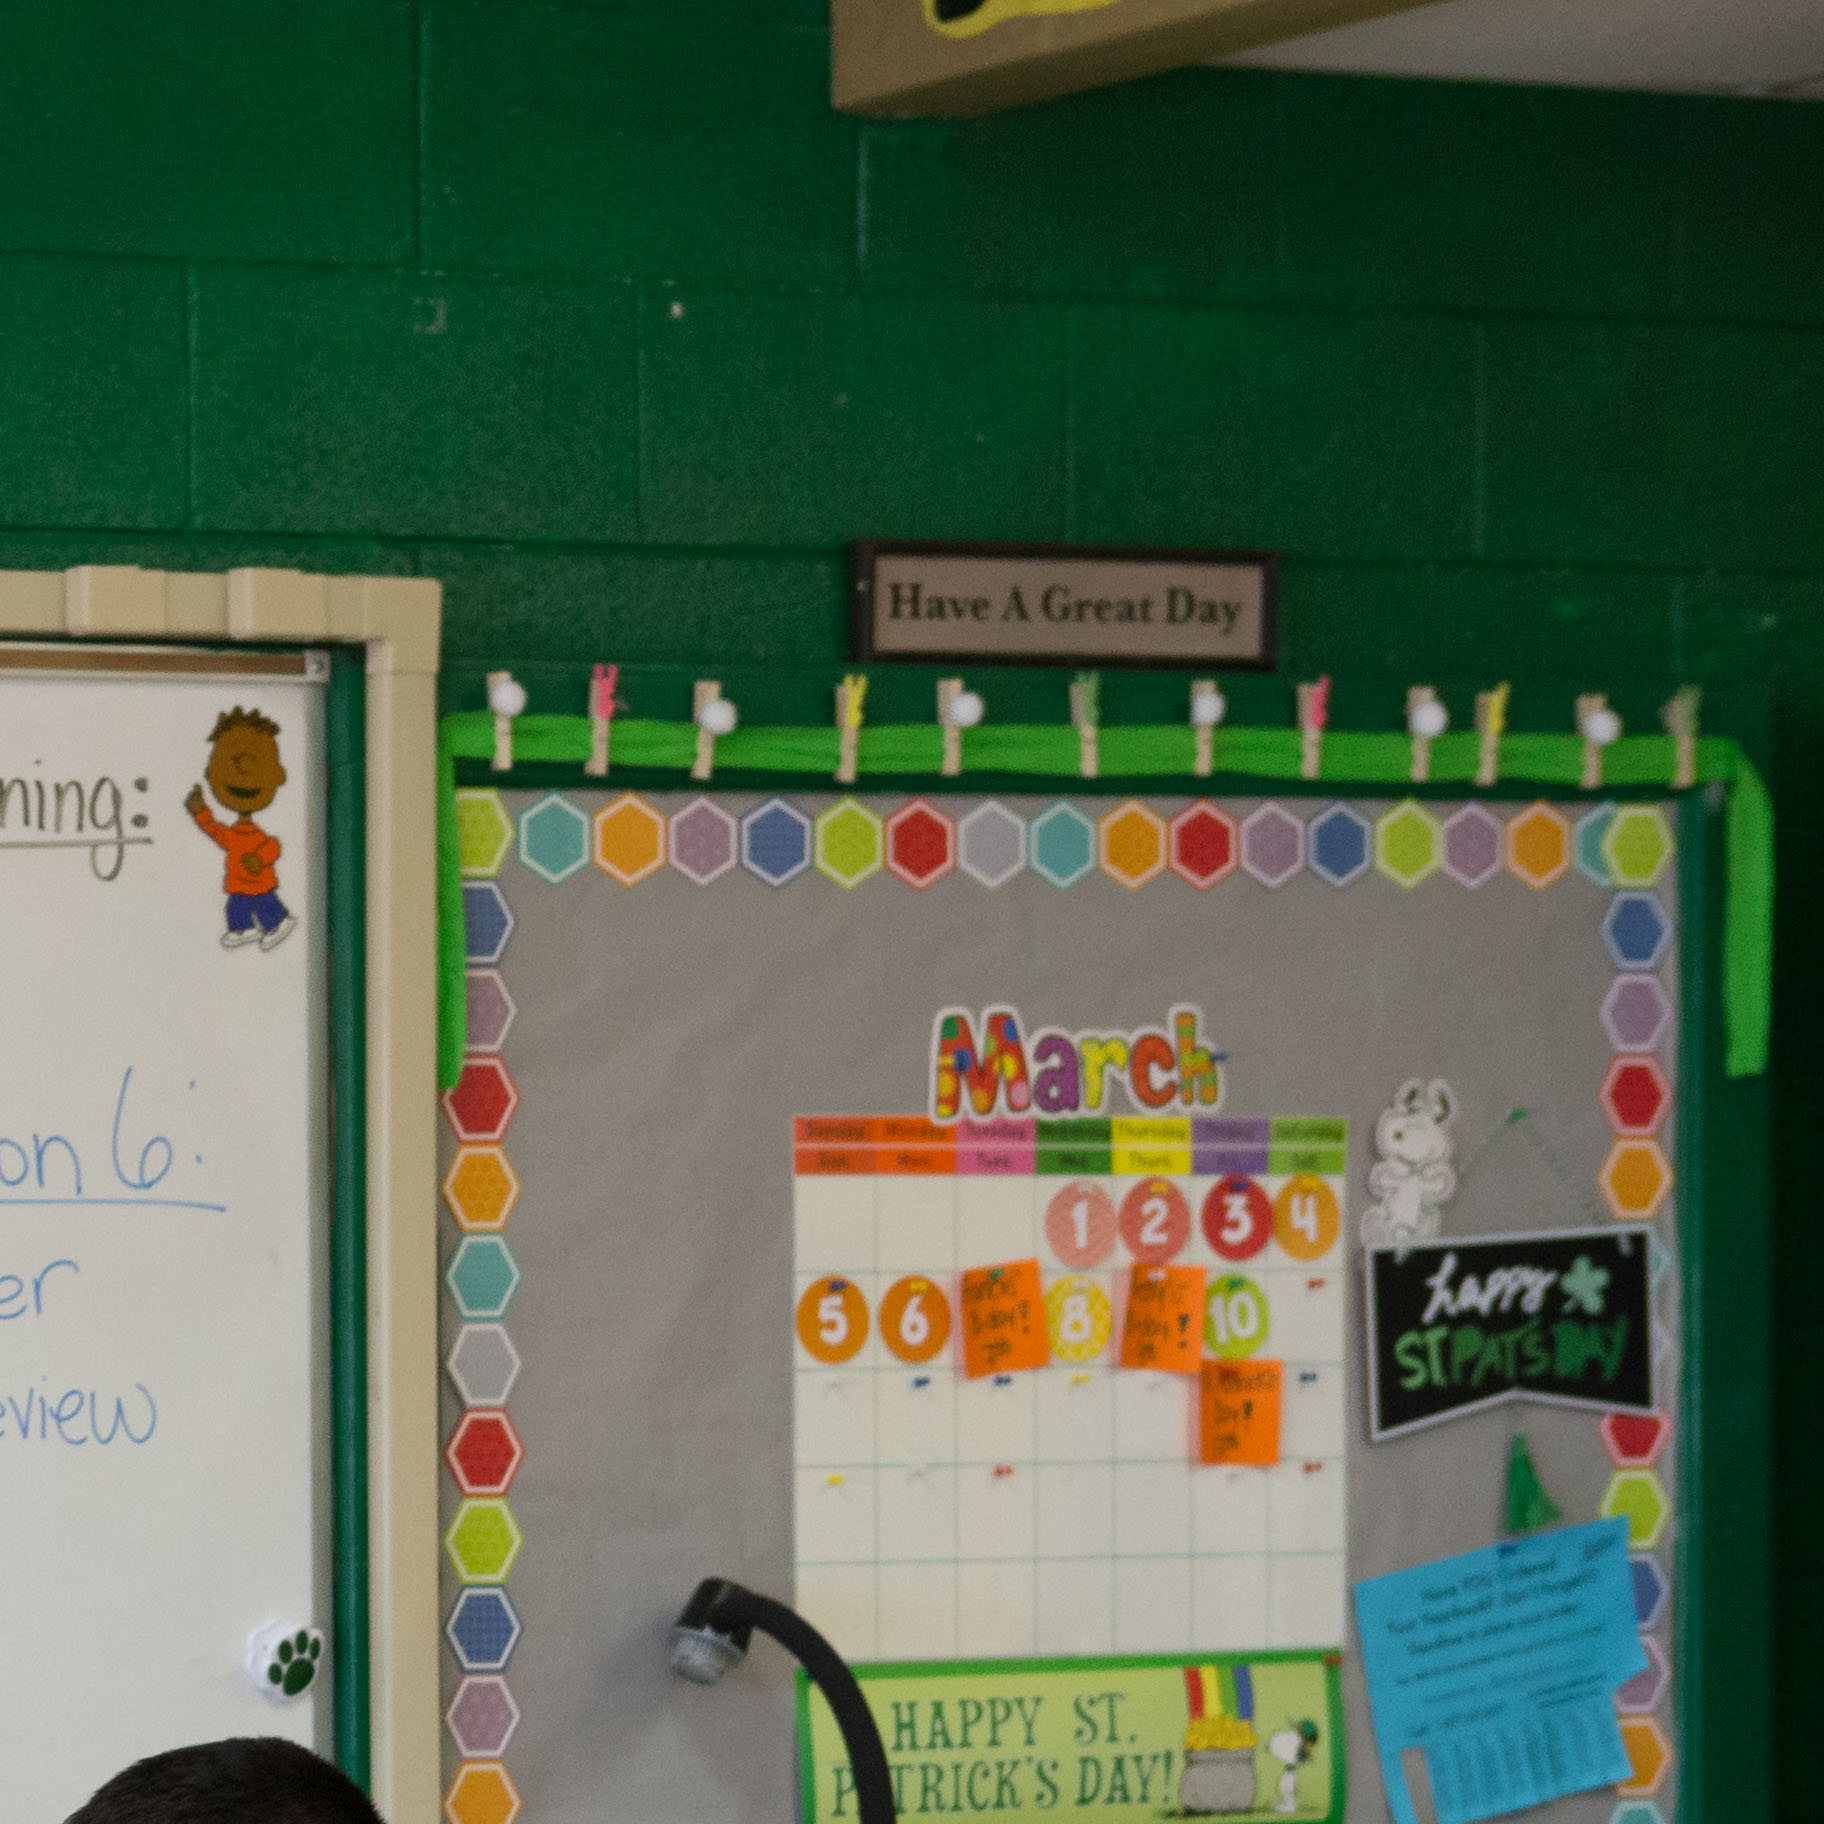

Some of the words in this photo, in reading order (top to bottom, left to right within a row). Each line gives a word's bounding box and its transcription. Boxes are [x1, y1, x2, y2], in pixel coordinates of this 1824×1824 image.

[887, 582, 991, 622] Have
[1000, 584, 1032, 624] A
[1040, 583, 1155, 625] Great
[1164, 584, 1244, 637] Day
[935, 1010, 1222, 1119] March
[1070, 1203, 1090, 1250] 1
[1139, 1199, 1170, 1246] 2
[1220, 1194, 1254, 1244] 3
[1289, 1194, 1320, 1243] 4
[817, 1295, 850, 1347] 5
[899, 1294, 931, 1348] 6
[1059, 1293, 1093, 1344] 8
[1210, 1291, 1260, 1346] 10
[889, 1696, 1047, 1752] HAPPY
[1072, 1691, 1138, 1746] ST.
[830, 1755, 1061, 1818] PTRICK'S
[1075, 1748, 1176, 1808] DAY!
